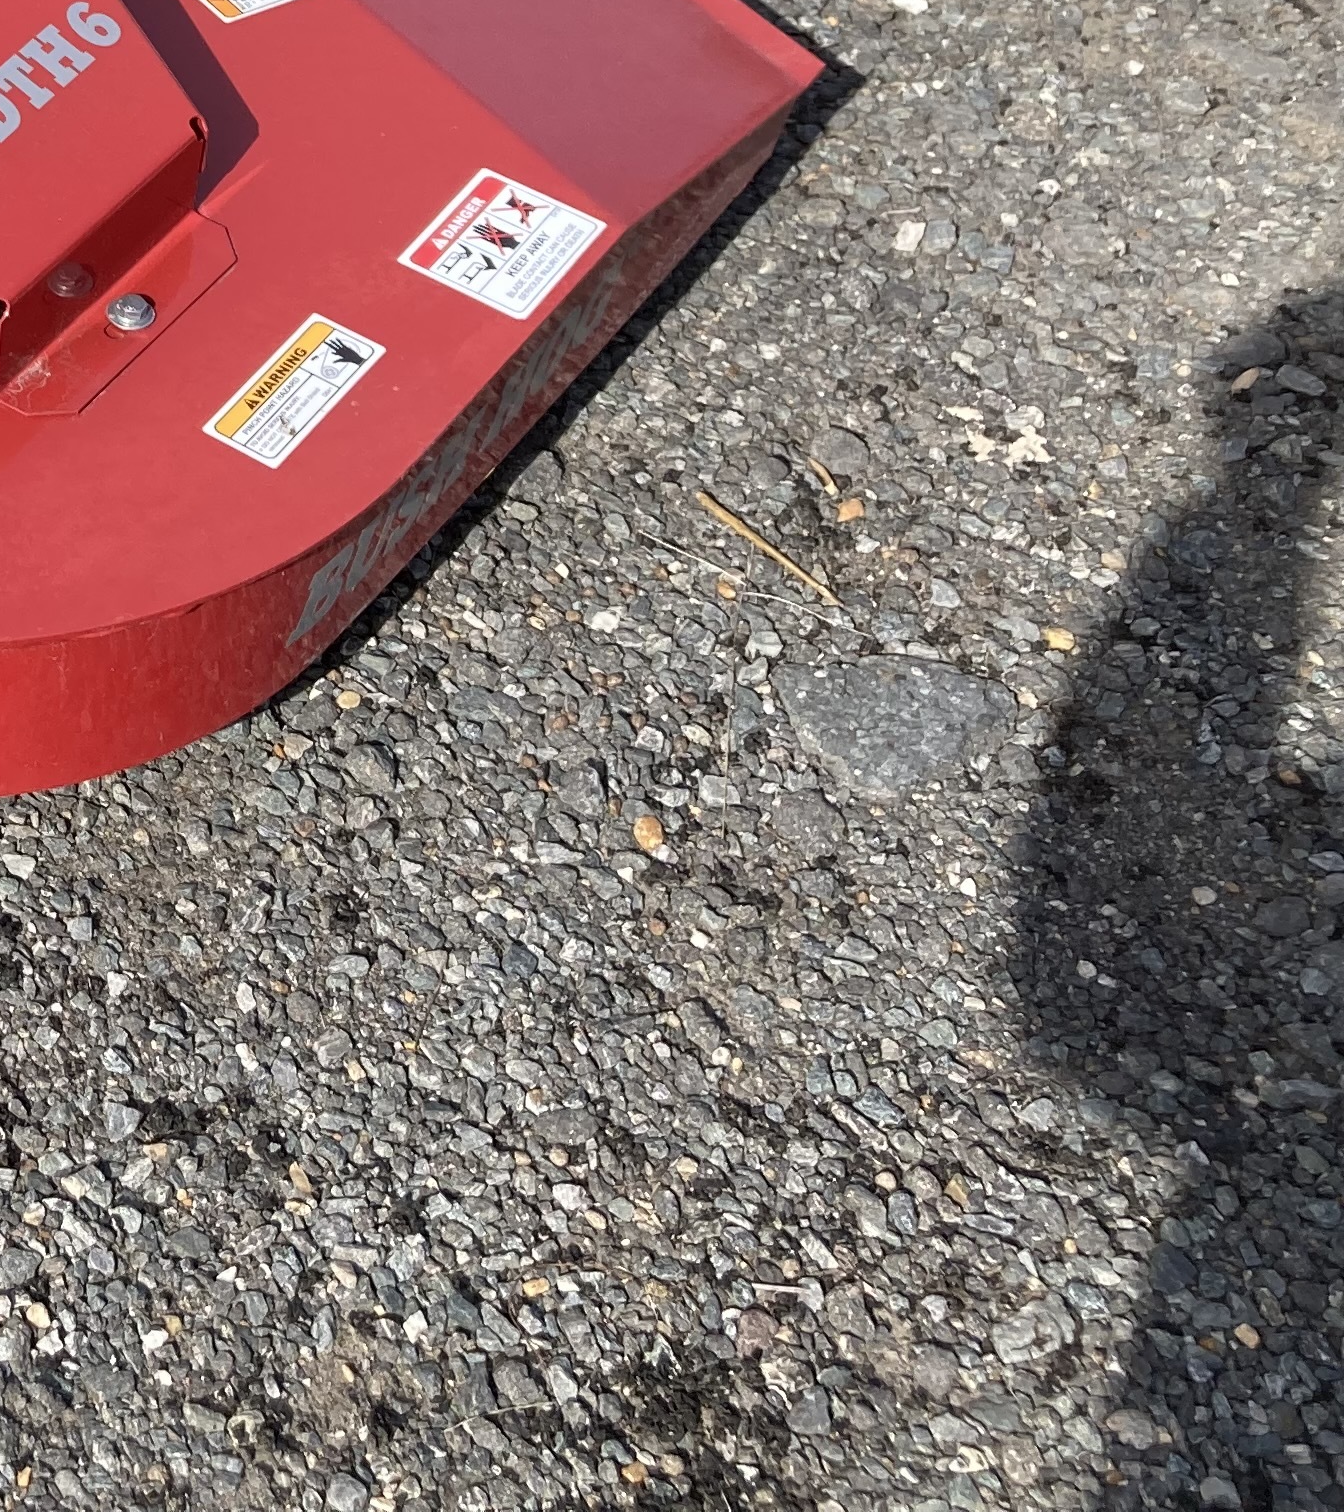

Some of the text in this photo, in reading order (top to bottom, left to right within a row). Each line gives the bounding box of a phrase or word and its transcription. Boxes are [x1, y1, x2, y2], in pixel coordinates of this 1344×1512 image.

[66, 1, 122, 47] 6
[440, 196, 486, 239] DANGER
[504, 230, 552, 277] KEEP AWAY
[252, 346, 308, 399] WARNING
[241, 415, 262, 435] PINCH
[258, 399, 278, 417] POINT
[274, 376, 300, 400] HAZARD
